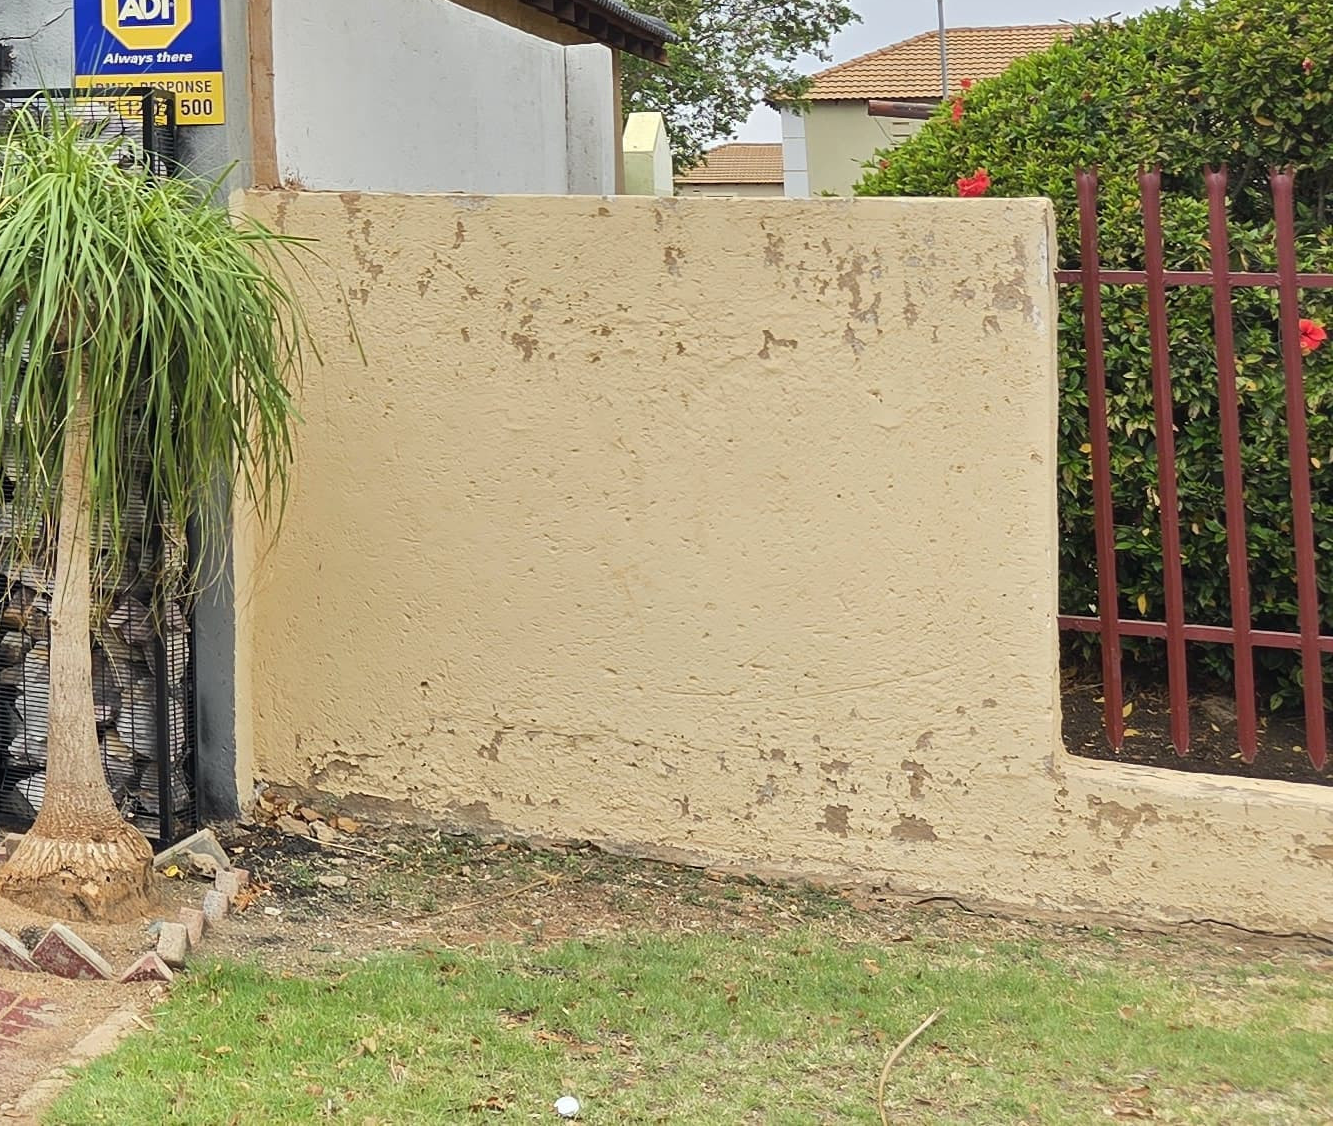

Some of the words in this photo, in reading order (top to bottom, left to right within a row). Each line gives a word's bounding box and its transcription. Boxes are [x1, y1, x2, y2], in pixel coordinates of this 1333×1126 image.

[103, 53, 154, 66] Always
[156, 51, 193, 63] there
[180, 98, 213, 116] 500
